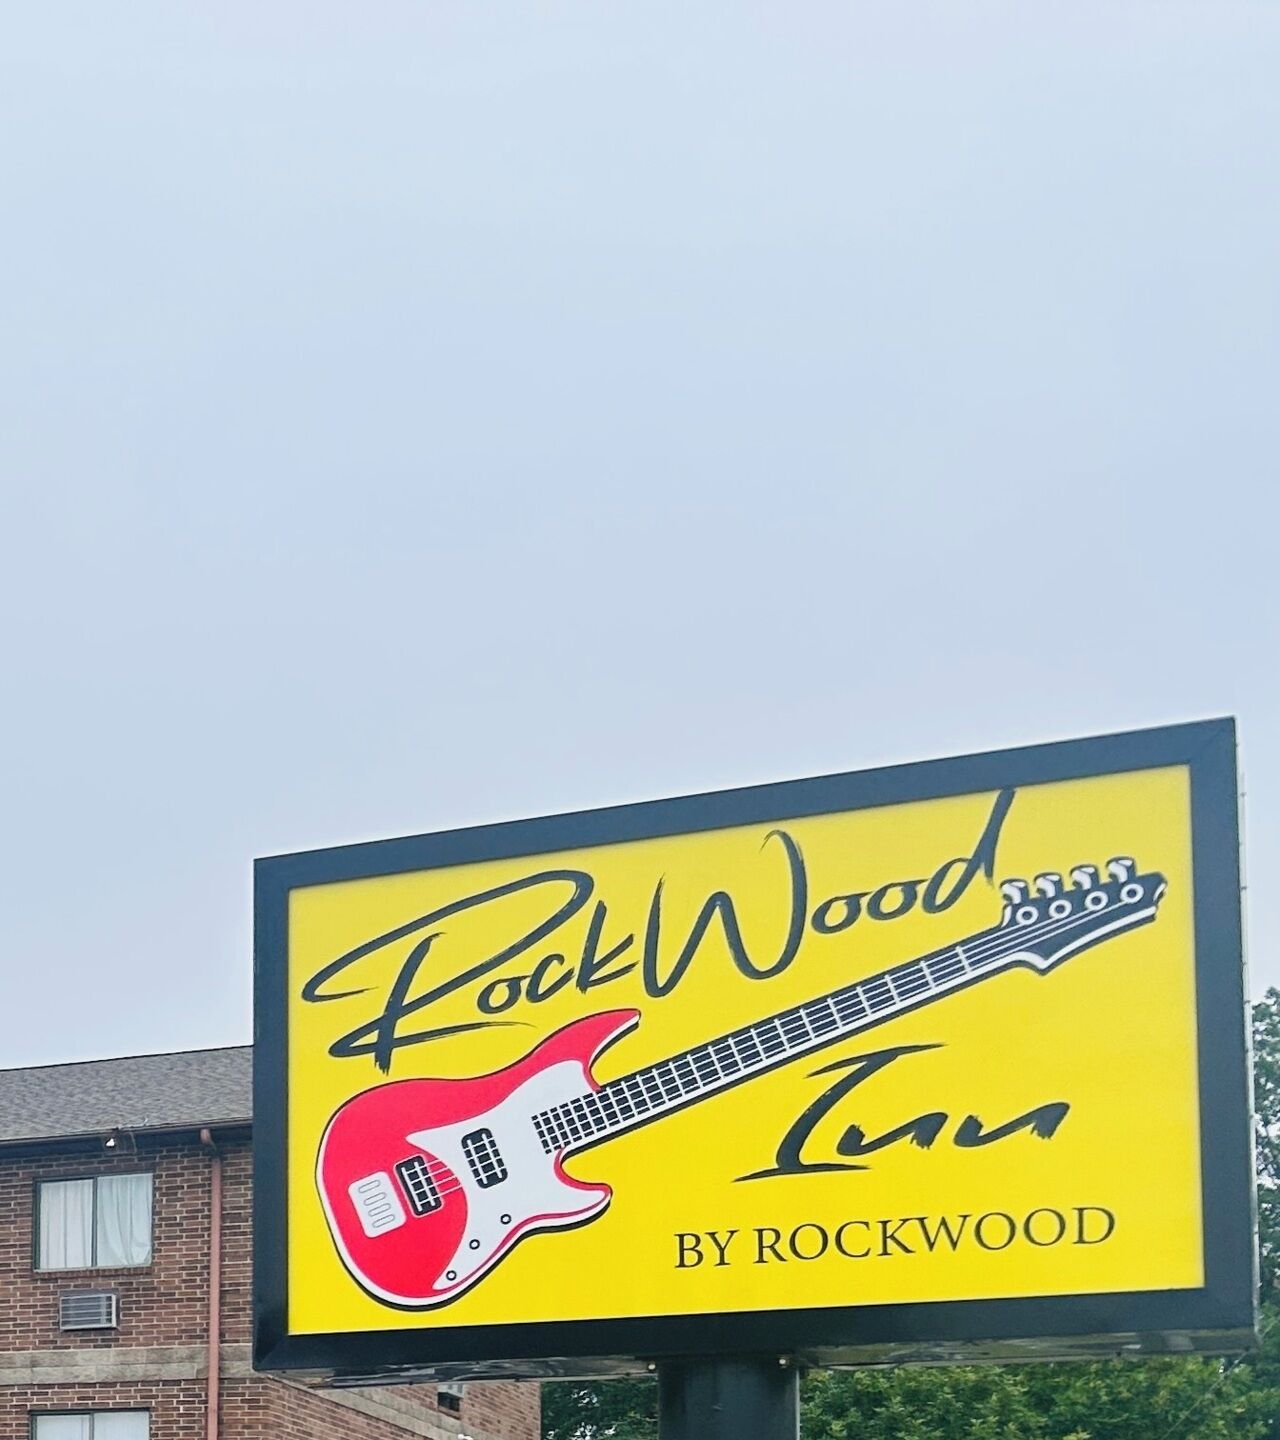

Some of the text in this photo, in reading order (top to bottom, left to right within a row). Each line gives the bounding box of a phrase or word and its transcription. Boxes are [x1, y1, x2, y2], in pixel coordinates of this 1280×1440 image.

[731, 1042, 1071, 1183] Inn
[674, 1206, 1116, 1269] BY ROCKWOOD
